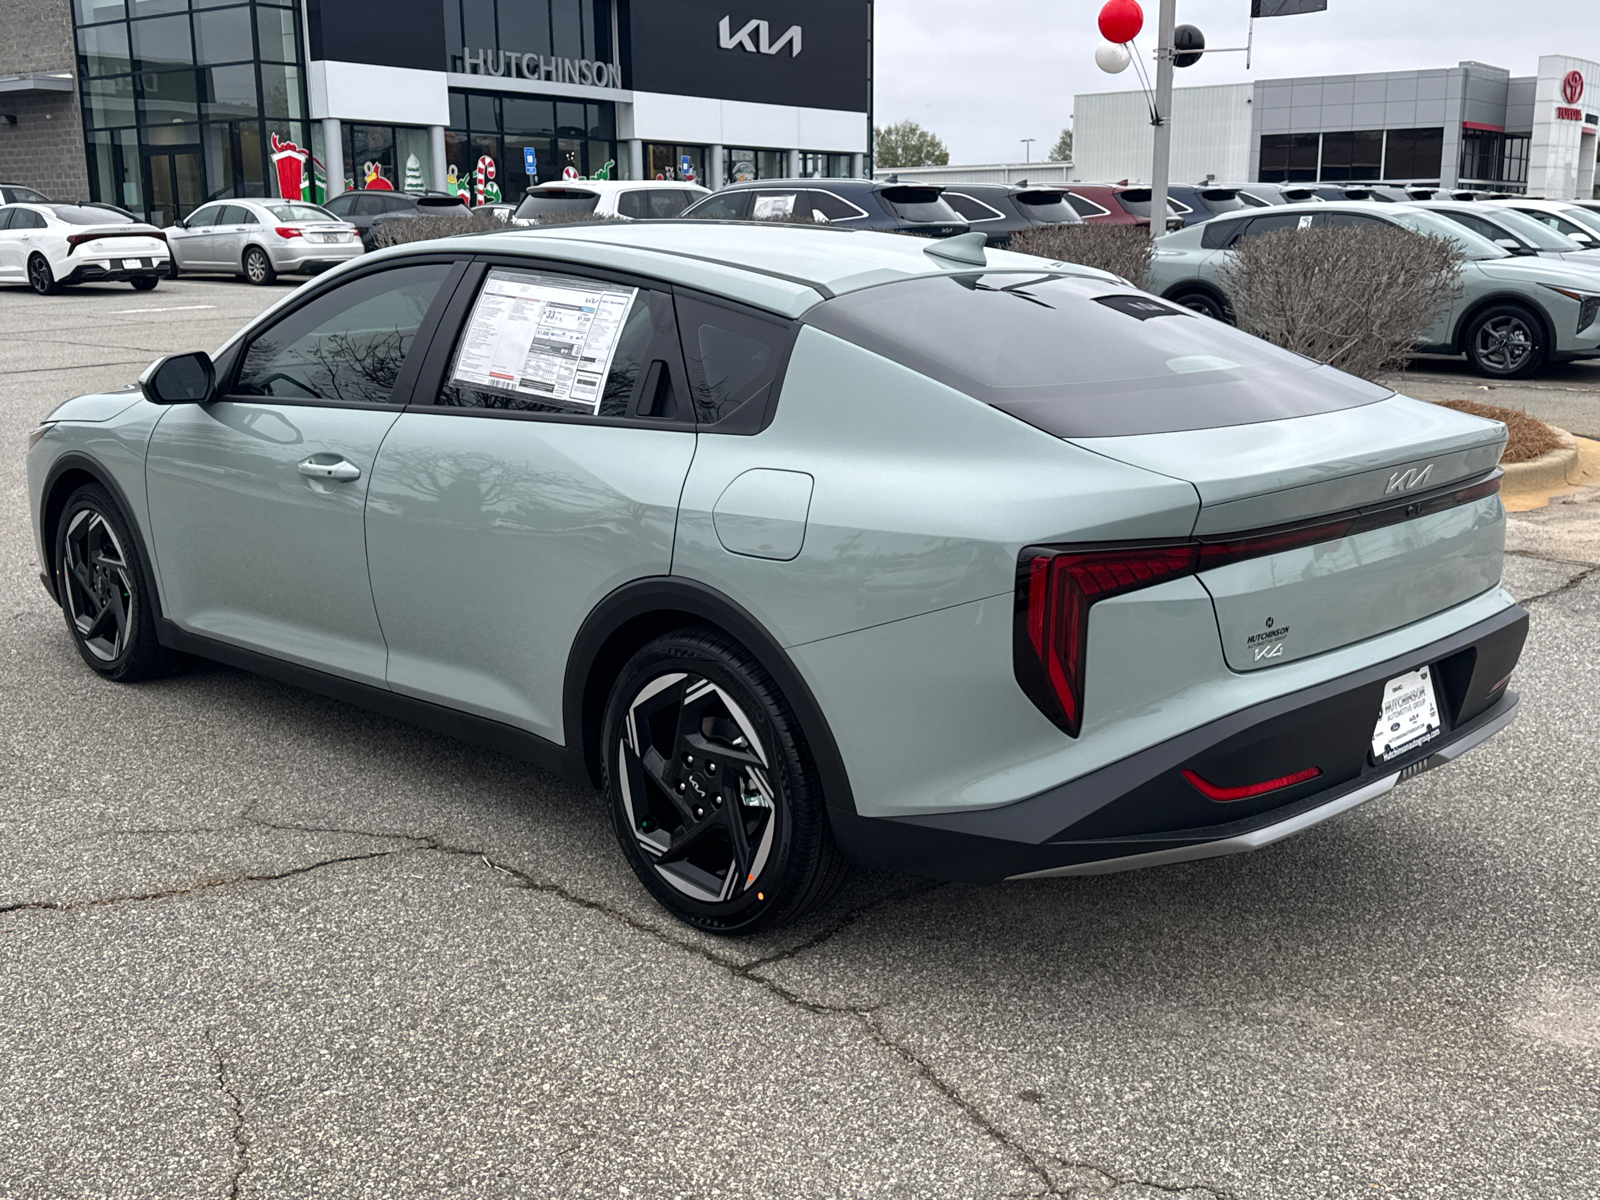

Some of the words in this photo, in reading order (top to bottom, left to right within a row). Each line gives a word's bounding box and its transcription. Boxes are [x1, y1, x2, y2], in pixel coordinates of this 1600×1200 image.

[718, 14, 802, 58] KIA
[464, 47, 622, 90] HUTCHINSON
[1556, 106, 1582, 121] TOYOTA
[1384, 463, 1434, 494] KIA
[1246, 626, 1290, 644] HUTCHINSON
[1254, 643, 1283, 661] K4
[1385, 687, 1425, 714] HUTCHINSON
